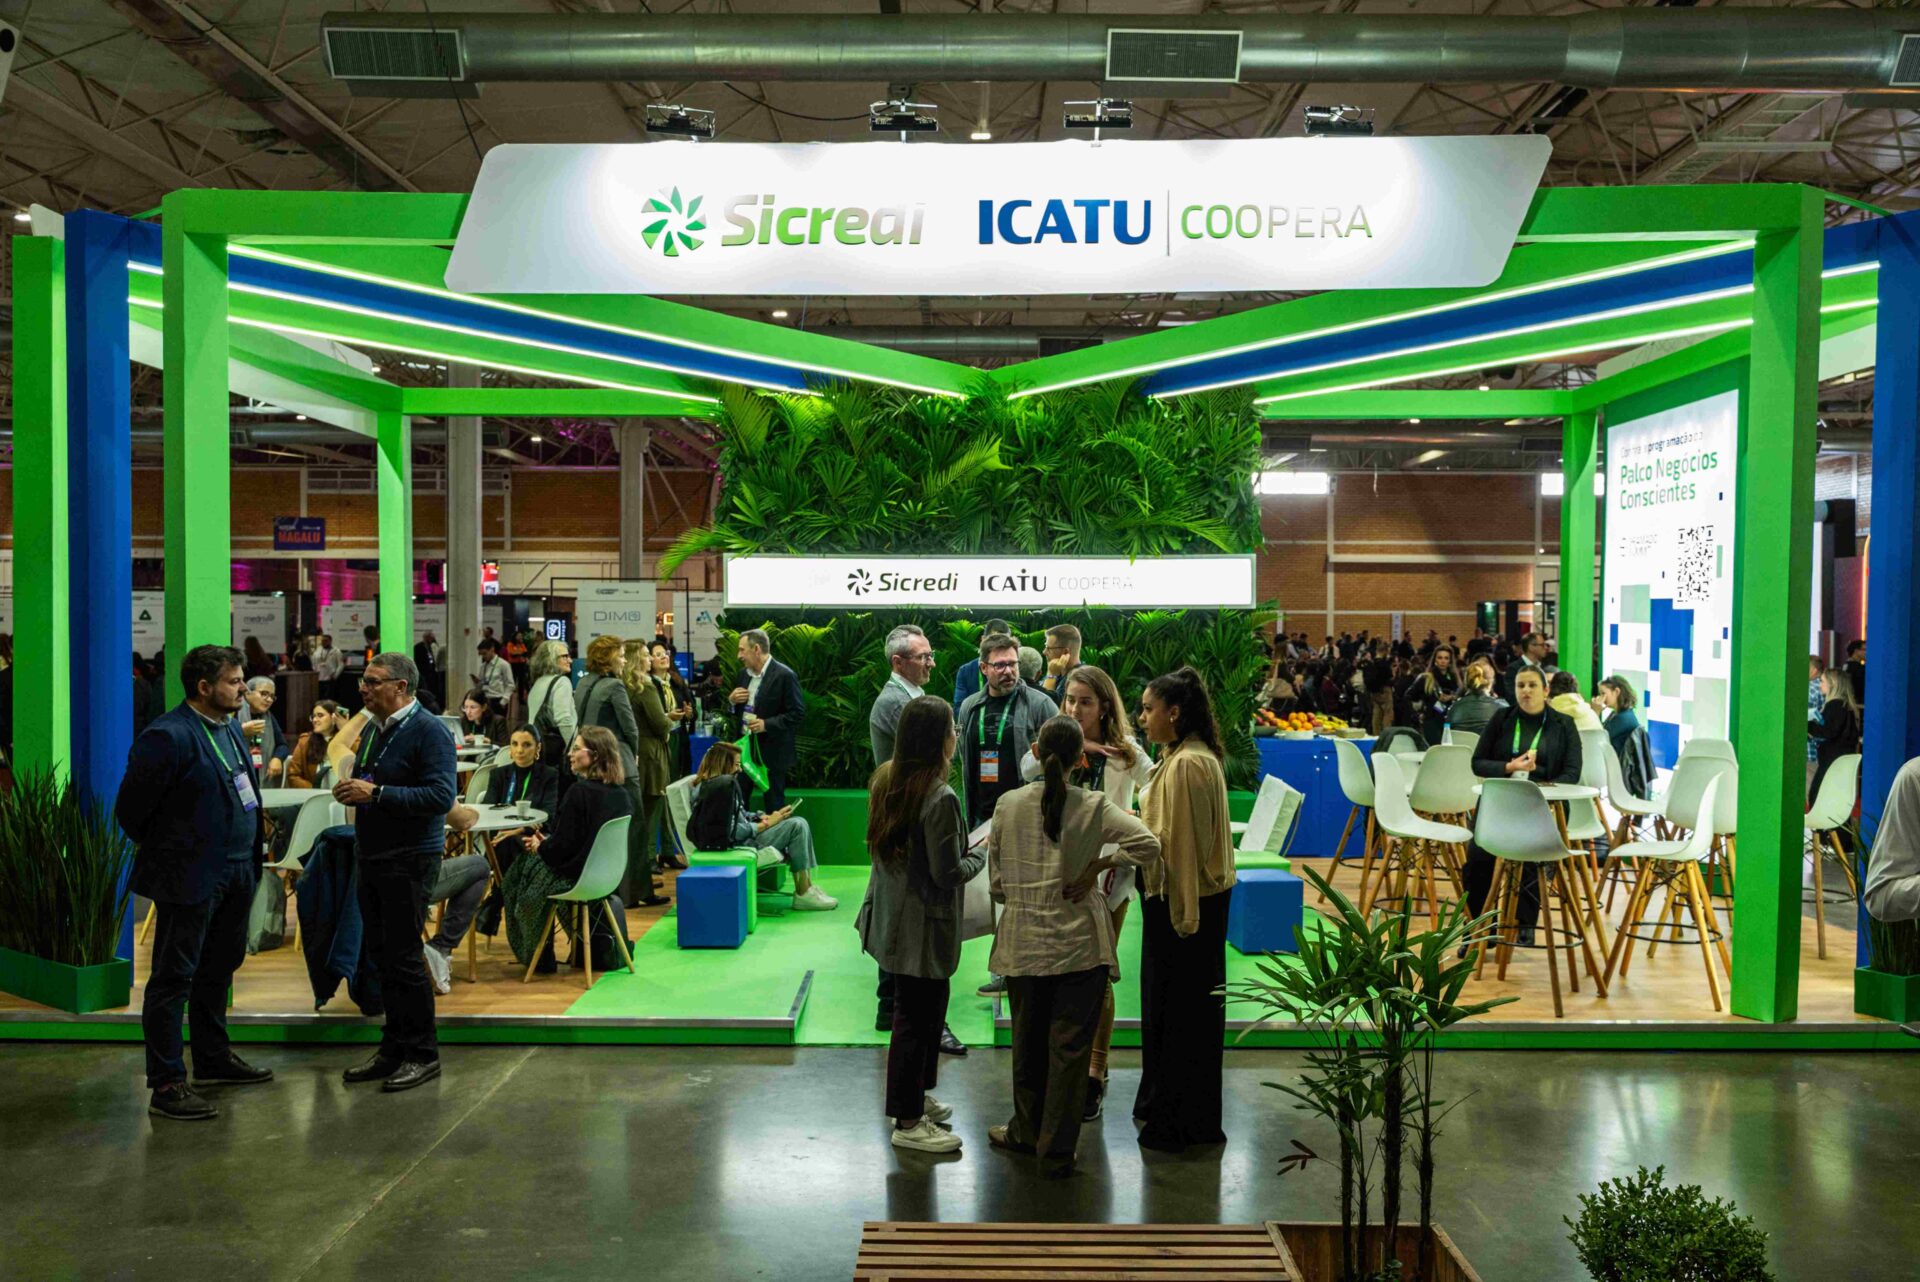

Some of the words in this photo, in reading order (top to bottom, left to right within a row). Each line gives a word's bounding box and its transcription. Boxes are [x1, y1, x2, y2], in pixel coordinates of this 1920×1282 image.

[721, 194, 926, 247] Sicredi
[978, 199, 1152, 246] ICATU
[1180, 204, 1373, 240] COOPERA
[1620, 462, 1652, 485] Palco
[1656, 449, 1718, 481] Negócios
[1620, 483, 1696, 510] Conscientes
[878, 572, 959, 592] Sicredi
[979, 568, 1047, 592] ICATU
[1058, 576, 1134, 591] COOPERA
